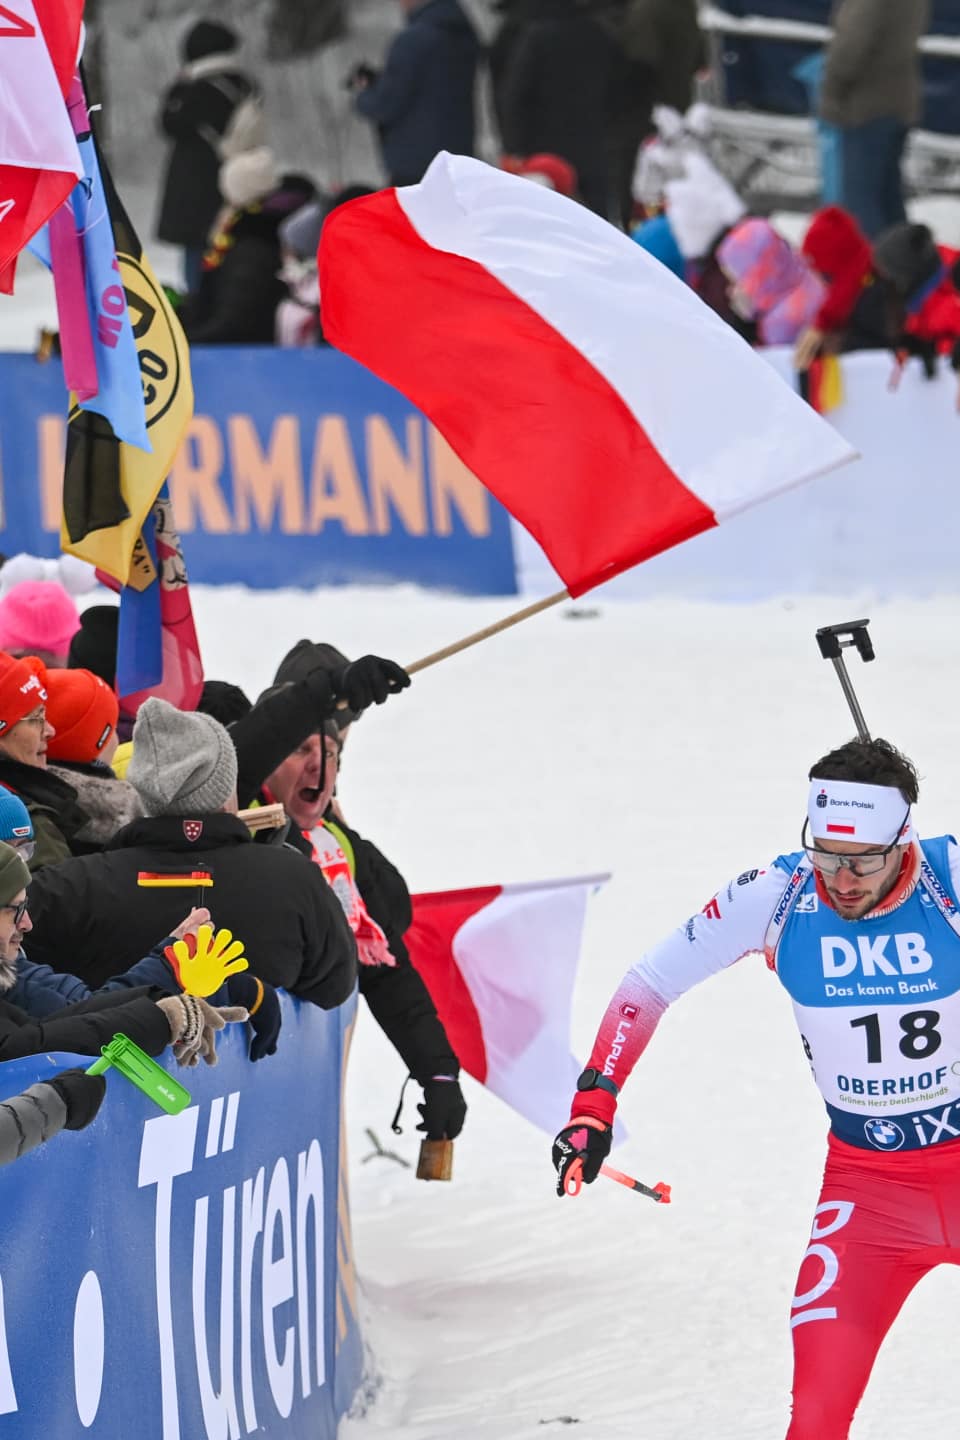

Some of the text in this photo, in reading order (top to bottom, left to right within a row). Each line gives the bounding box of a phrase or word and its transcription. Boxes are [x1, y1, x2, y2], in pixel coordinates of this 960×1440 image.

[40, 413, 490, 537] RMANN
[830, 799, 850, 807] Bank
[852, 800, 874, 810] Polski
[773, 866, 804, 926] INCORSA
[920, 860, 959, 915] INCORSA
[820, 932, 933, 978] DKB
[825, 978, 939, 997] Das kann Bank
[602, 1020, 632, 1076] LAPUA
[850, 1010, 941, 1063] 18
[837, 1066, 947, 1096] OBERHOF
[839, 1086, 949, 1107] Grünes Herz Deutschlands
